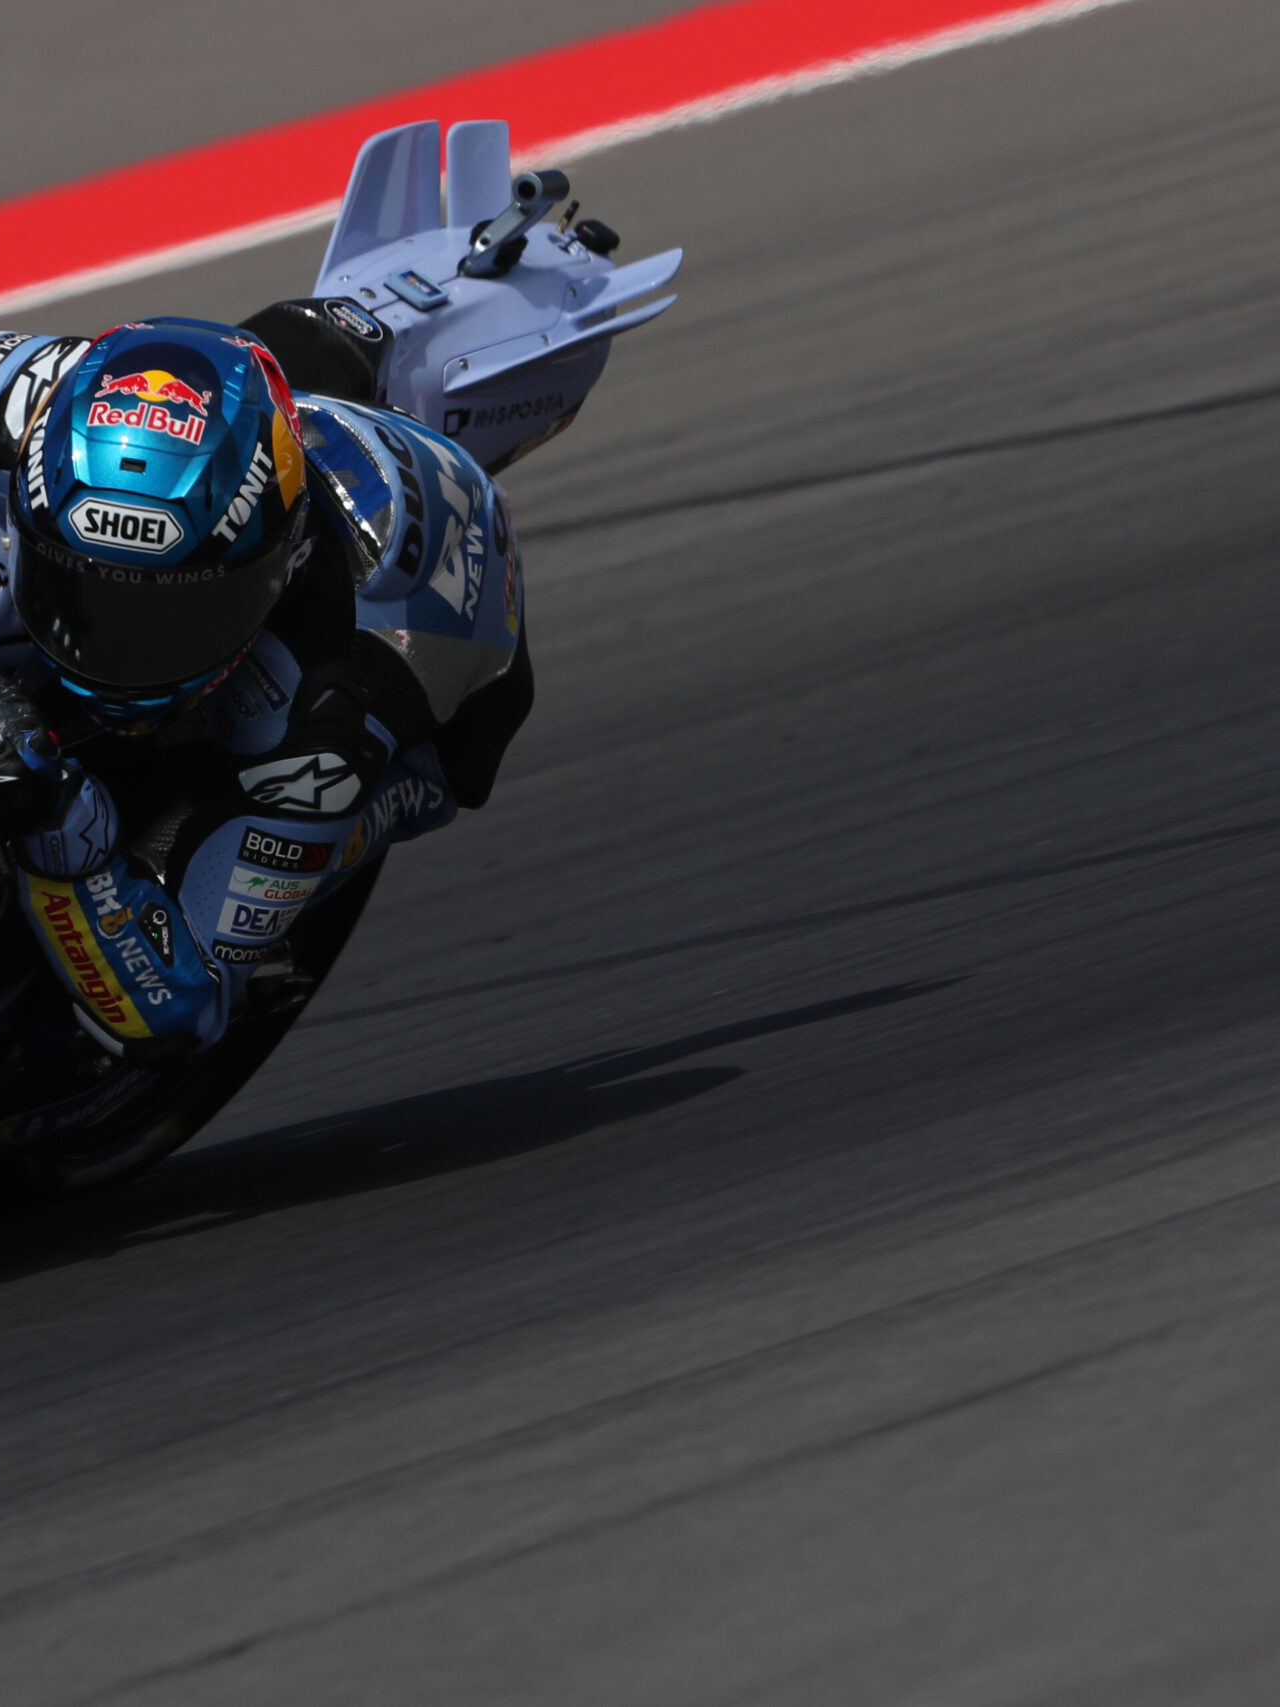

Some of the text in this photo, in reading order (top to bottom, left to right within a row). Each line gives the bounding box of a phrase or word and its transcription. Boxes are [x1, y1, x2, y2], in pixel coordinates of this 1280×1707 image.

[87, 402, 205, 446] Red Bull
[474, 393, 563, 428] RISPOSTA
[84, 508, 165, 545] SHOEI
[36, 542, 226, 585] GIVES YOU WINGS
[242, 851, 298, 869] RIDERS
[246, 832, 303, 860] BOLD
[270, 879, 299, 890] AUS
[86, 870, 172, 1006] BK8 NEWS
[42, 891, 127, 1023] Antangin
